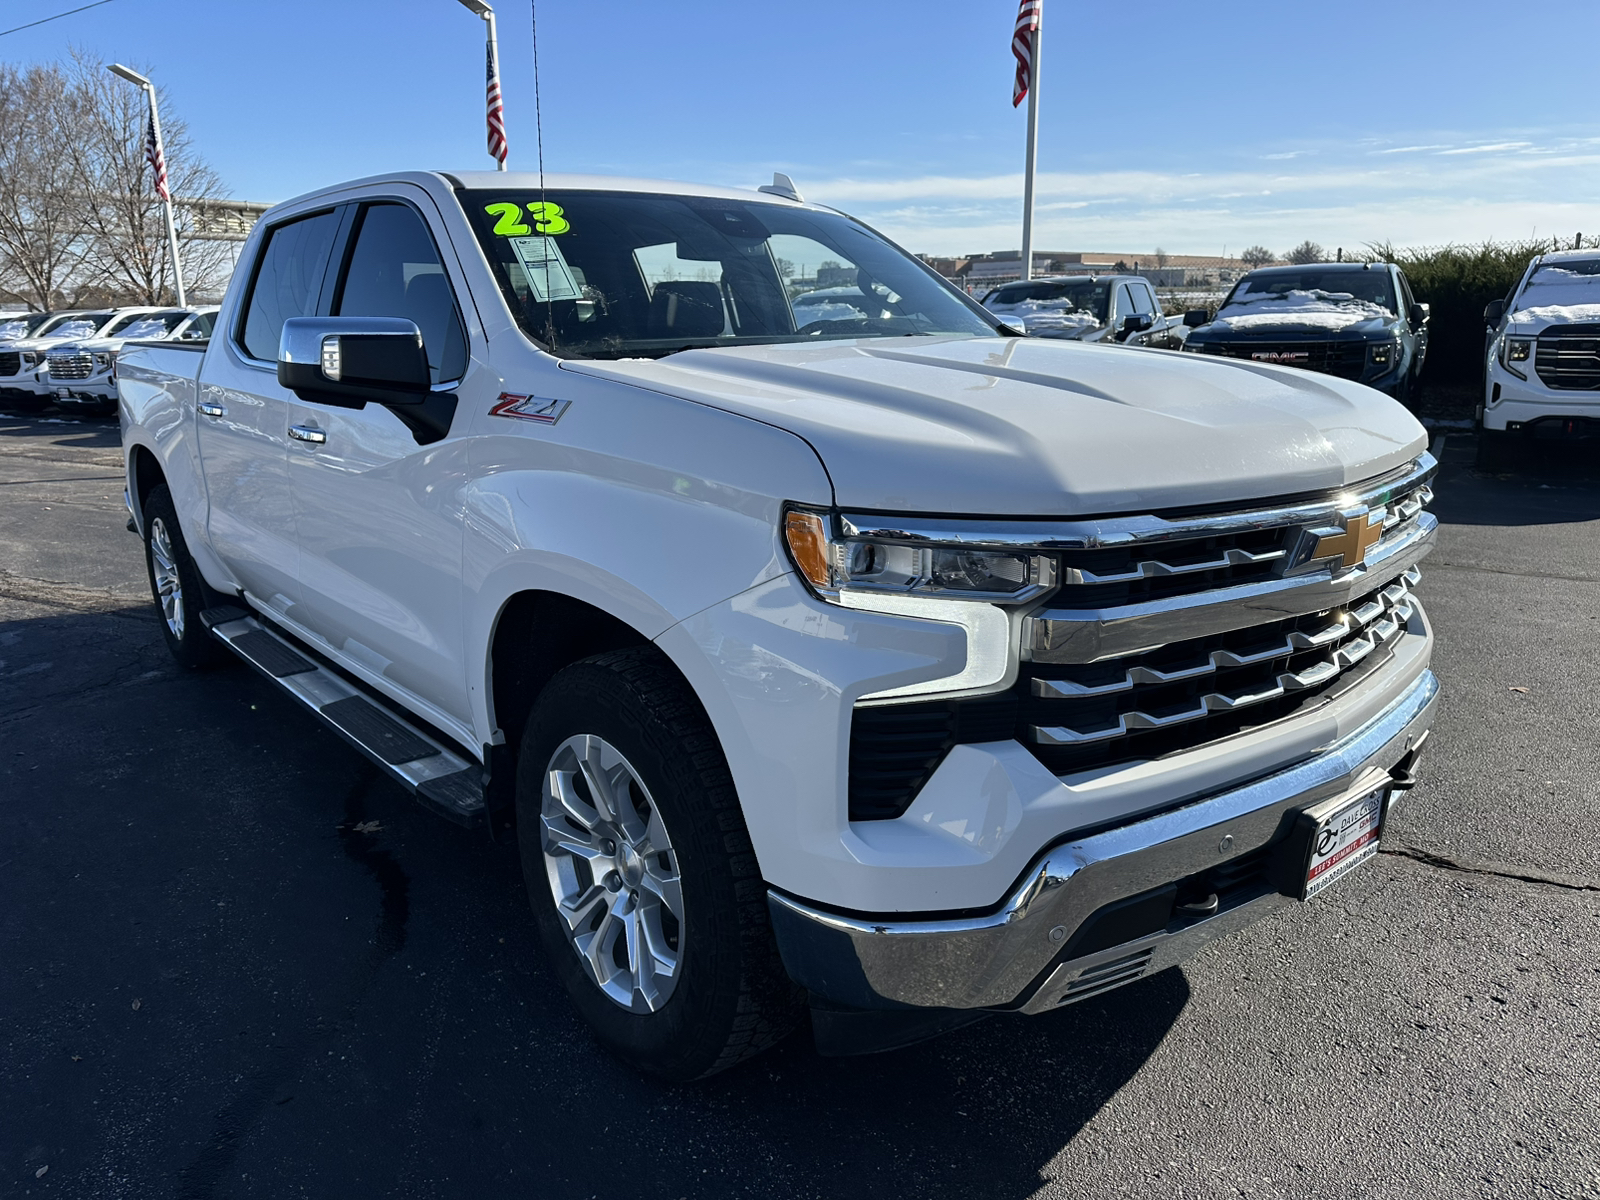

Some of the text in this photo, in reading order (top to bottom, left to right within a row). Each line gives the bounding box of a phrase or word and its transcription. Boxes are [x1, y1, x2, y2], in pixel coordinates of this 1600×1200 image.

[484, 201, 570, 236] 23
[1251, 352, 1309, 363] GMC
[487, 391, 573, 426] Z71
[1341, 809, 1359, 830] DAVE
[1359, 811, 1378, 830] GMC
[1314, 858, 1332, 876] LEE'S
